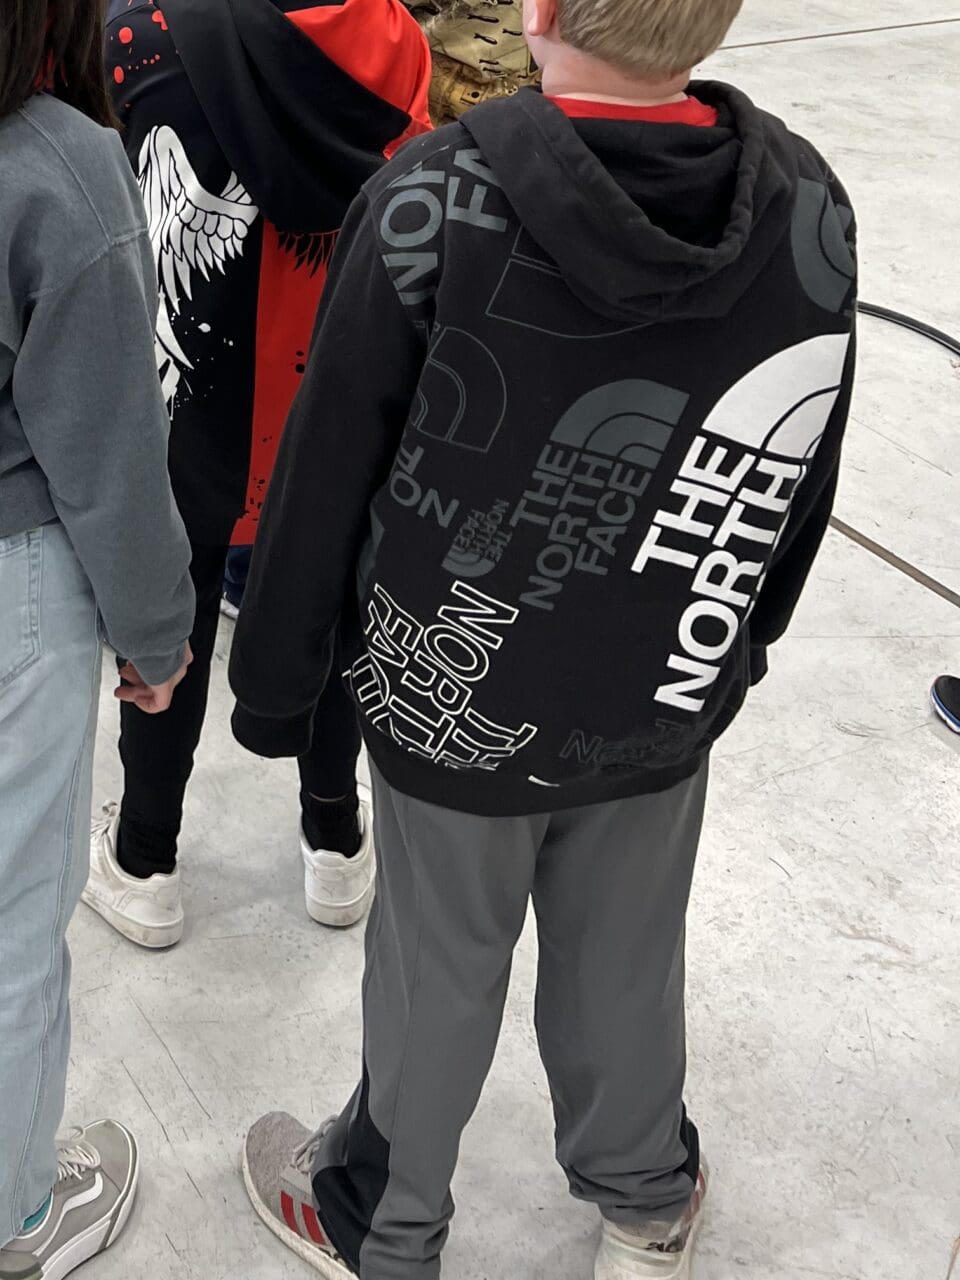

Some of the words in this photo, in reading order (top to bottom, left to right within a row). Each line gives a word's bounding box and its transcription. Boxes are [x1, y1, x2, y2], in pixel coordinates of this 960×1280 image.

[508, 443, 580, 527] THE
[518, 452, 614, 611] NORTH
[573, 462, 653, 576] FACE
[630, 435, 757, 574] THE
[653, 457, 803, 713] NORTH
